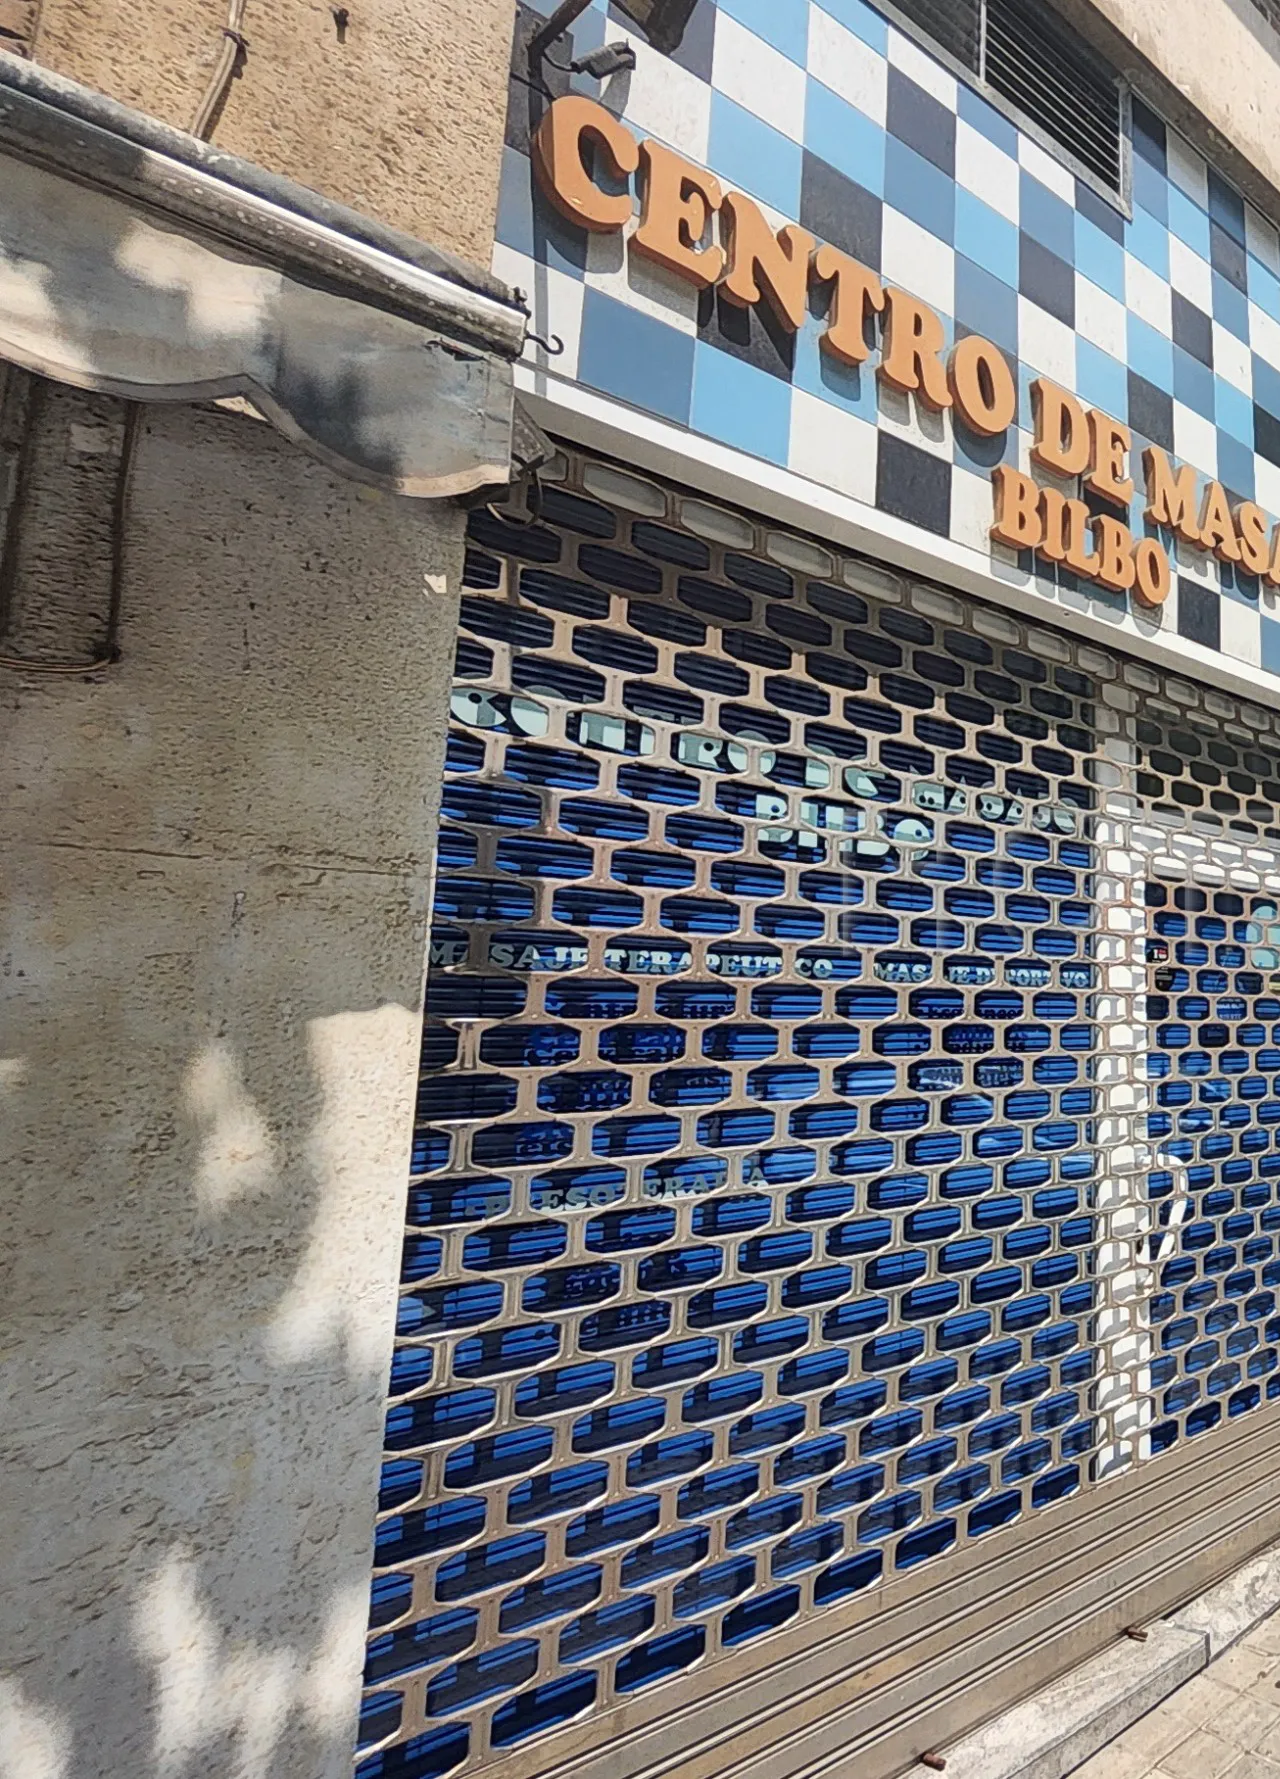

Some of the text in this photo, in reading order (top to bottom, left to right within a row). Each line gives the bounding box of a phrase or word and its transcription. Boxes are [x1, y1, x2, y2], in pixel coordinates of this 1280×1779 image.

[533, 96, 1015, 436] CENTRO
[1029, 377, 1135, 508] DE
[990, 463, 1171, 607] BILBO
[430, 940, 834, 978] MSAJE TERAPEUTCO
[873, 961, 1088, 989] MASJE DPORTVO
